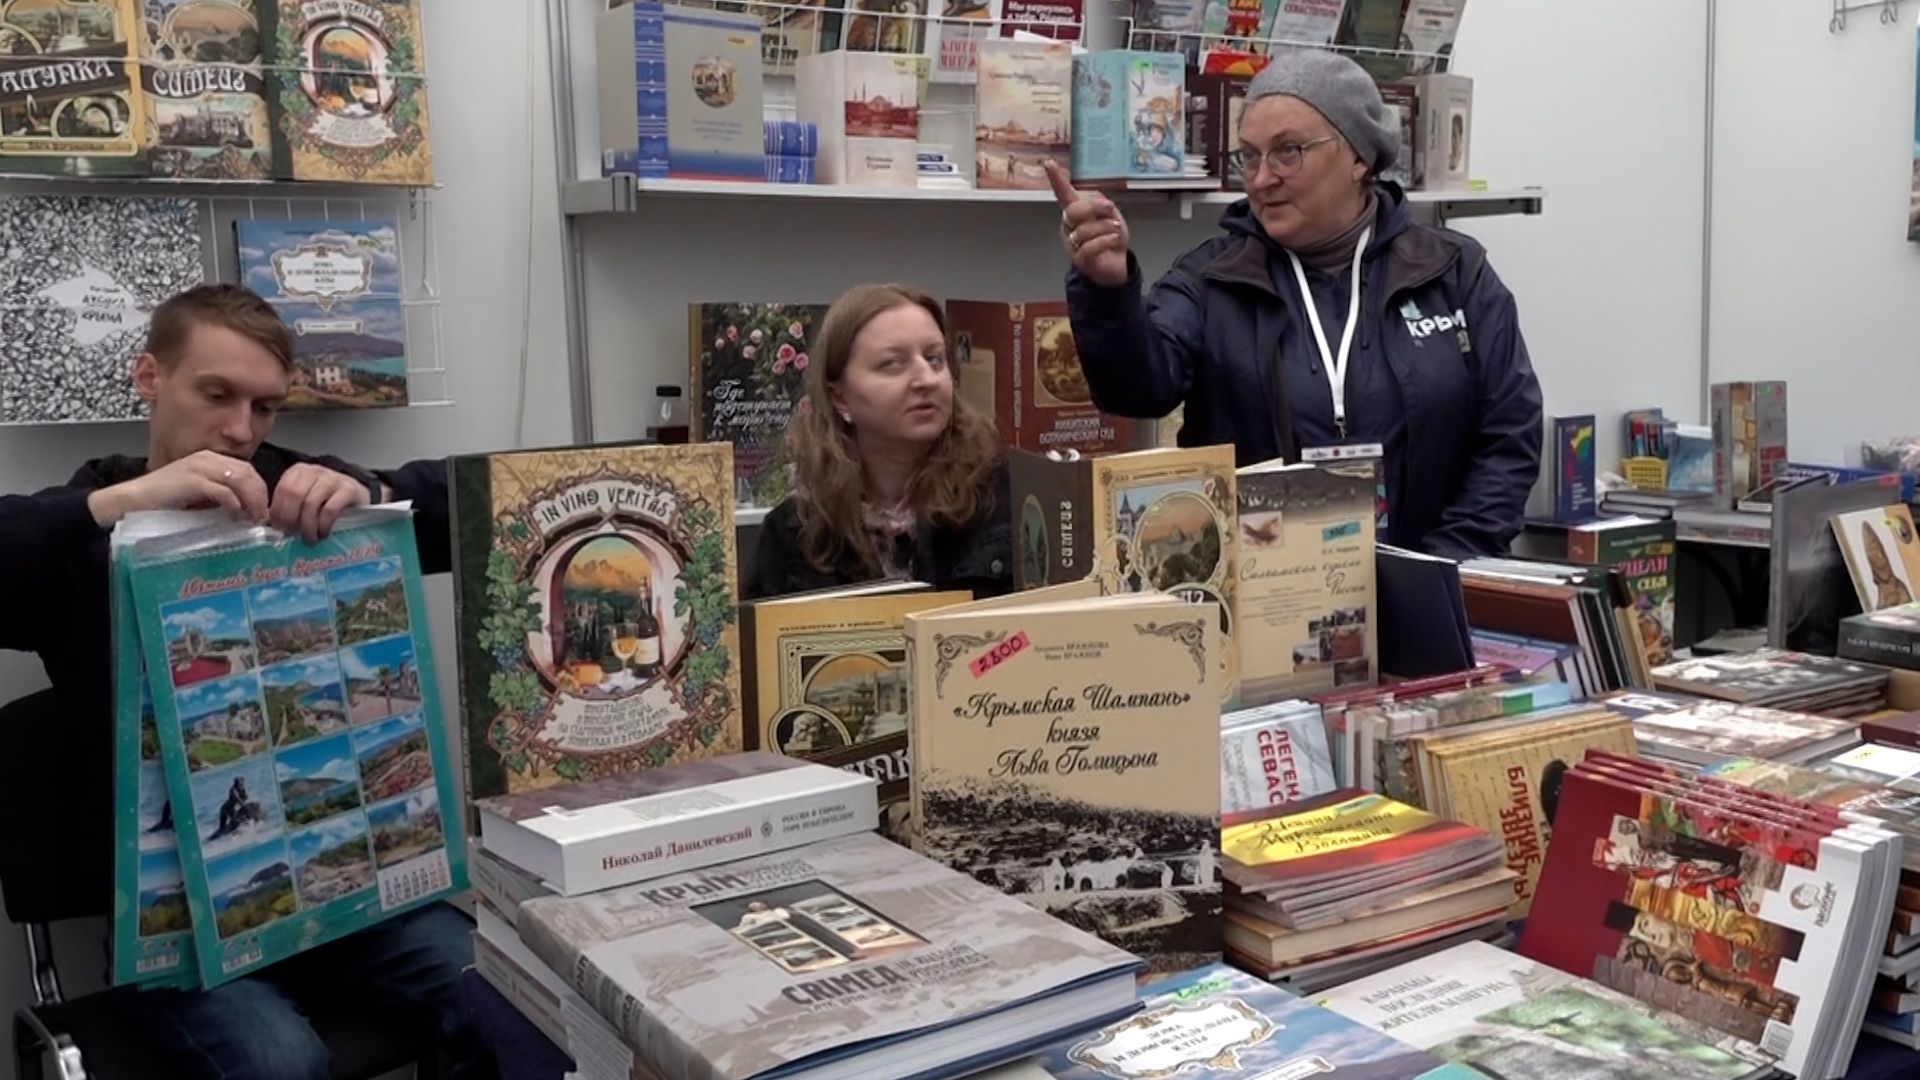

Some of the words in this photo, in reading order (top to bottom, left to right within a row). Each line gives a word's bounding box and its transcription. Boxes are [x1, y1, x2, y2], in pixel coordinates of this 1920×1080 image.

[152, 67, 247, 97] СИМЕИЗ
[713, 378, 745, 401] Где
[541, 506, 561, 525] IN
[560, 488, 600, 513] VINO
[606, 486, 670, 519] VERITAS
[953, 685, 1076, 727] «Крымская
[1081, 682, 1192, 711] Шампань»
[1045, 716, 1101, 744] князя
[988, 748, 1049, 778] Льва
[1055, 745, 1159, 776] Голицына
[1257, 728, 1285, 804] СЕВАС
[1275, 728, 1301, 801] ЛЕГЕН
[602, 846, 663, 871] Николай
[667, 826, 753, 859] Данилевский
[640, 872, 748, 905] КРЫМ
[781, 965, 911, 1005] CRIMEA
